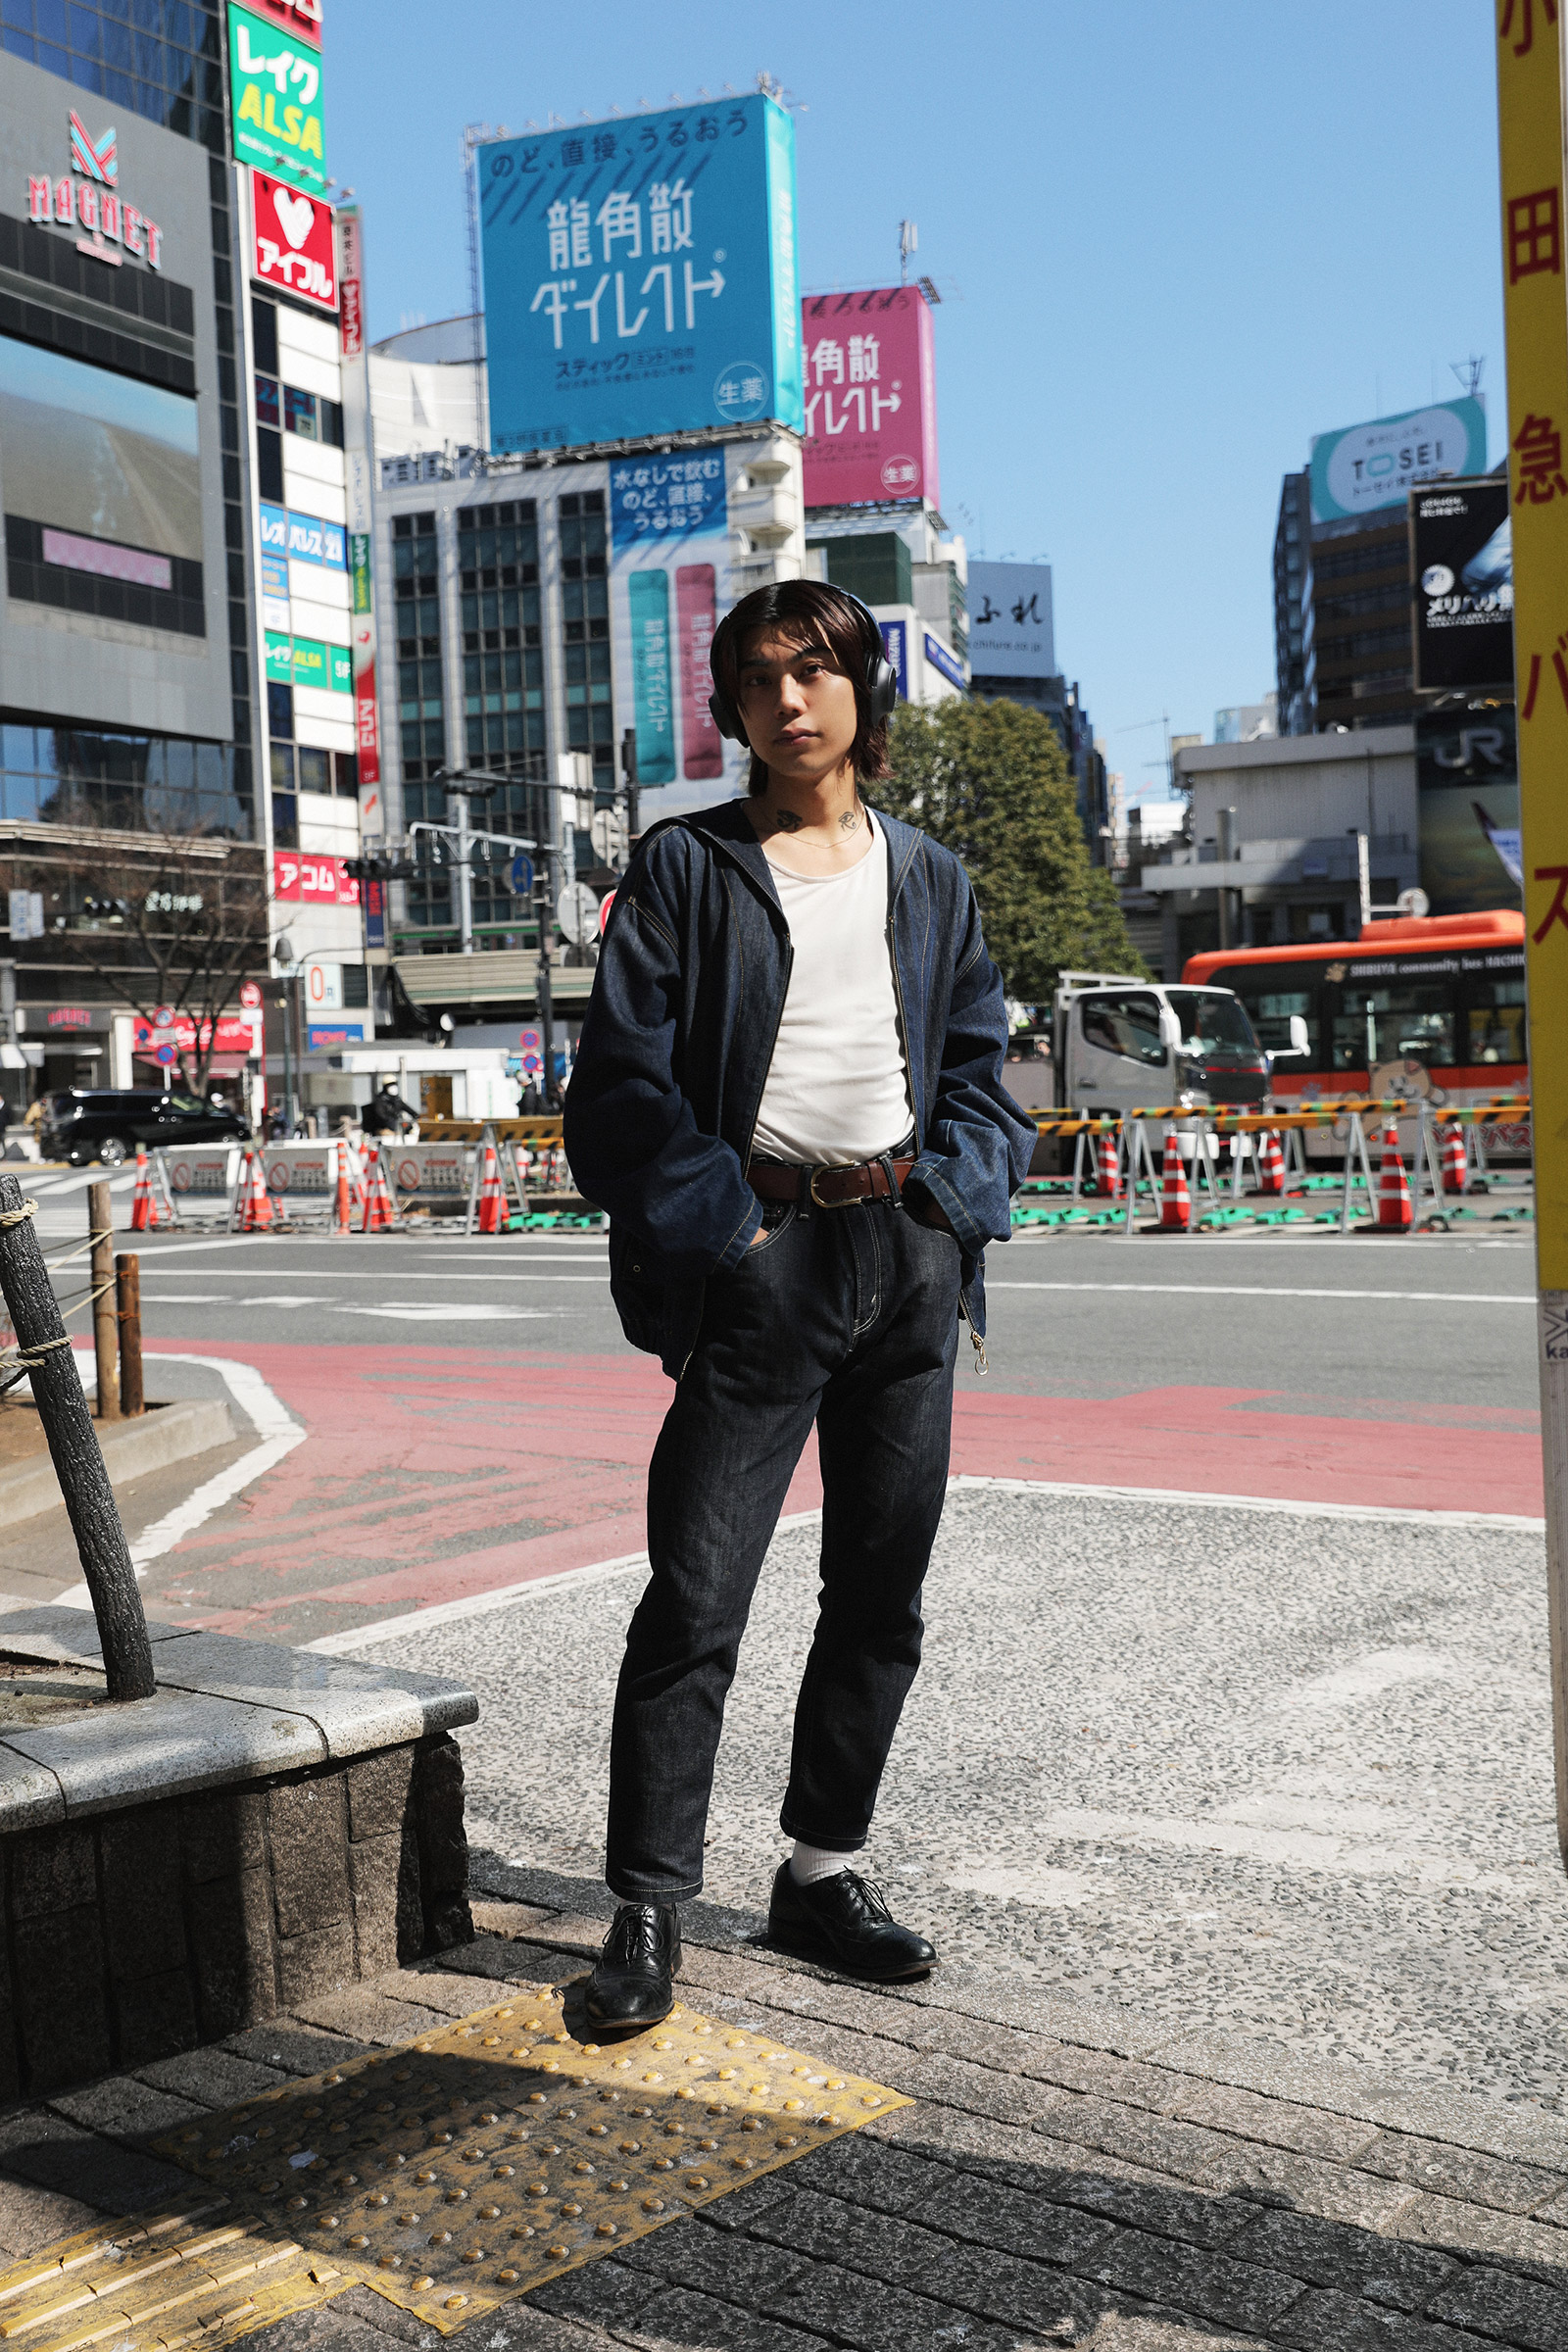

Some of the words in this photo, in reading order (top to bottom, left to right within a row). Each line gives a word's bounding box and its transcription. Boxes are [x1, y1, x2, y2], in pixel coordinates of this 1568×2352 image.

[237, 24, 319, 105] レイク
[237, 82, 323, 160] ALSA
[491, 109, 748, 178] のど、直接、うるおう
[28, 173, 164, 271] MAGNET
[547, 177, 694, 271] 龍角散
[257, 236, 332, 299] アイフル
[529, 261, 726, 350] ダイレクト
[556, 352, 630, 380] スティック
[717, 376, 764, 406] 生薬
[804, 386, 903, 438] イレクト
[613, 458, 720, 490] 水なしで飲む
[884, 465, 916, 484] 生薬
[1351, 440, 1445, 481] TOSEI
[621, 483, 713, 511] のど、直接、
[261, 515, 344, 563] レオパレス21
[633, 505, 705, 532] うるおう
[975, 592, 1045, 626] ふれ
[292, 648, 322, 669] ALSA
[359, 698, 375, 748] アコム
[1433, 727, 1505, 768] JR
[279, 861, 335, 893] アコム
[1349, 961, 1396, 978] SHIBUYA
[1398, 956, 1461, 976] community
[1461, 955, 1484, 970] bus
